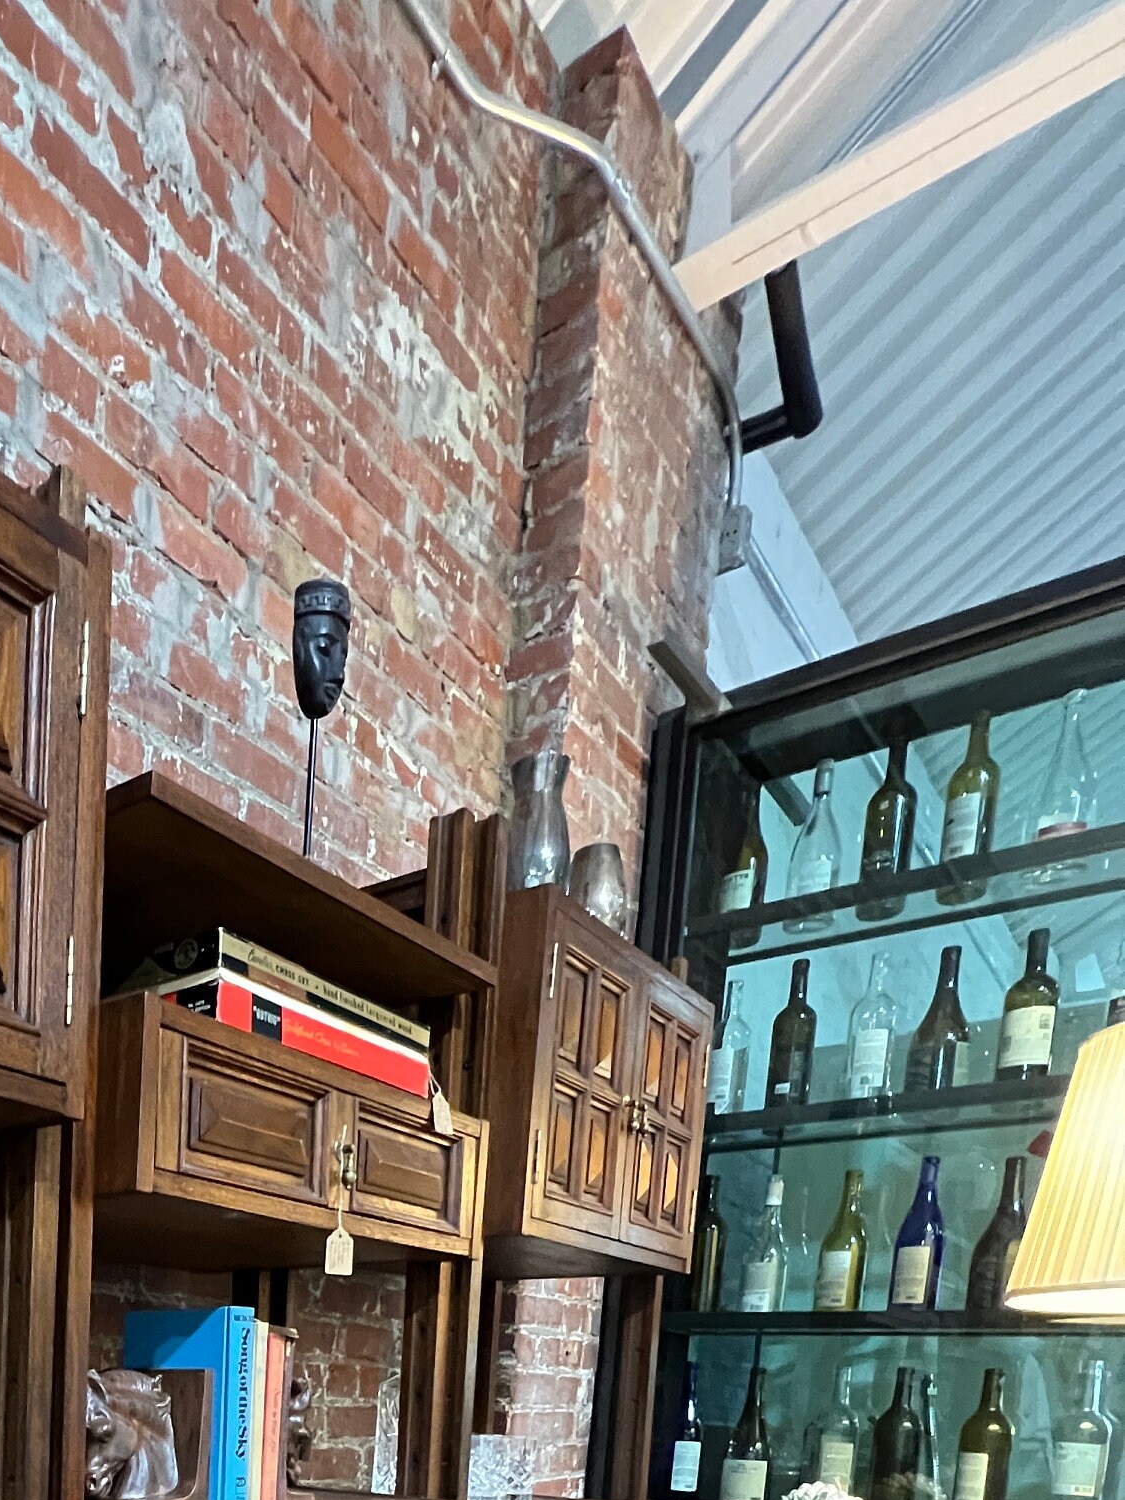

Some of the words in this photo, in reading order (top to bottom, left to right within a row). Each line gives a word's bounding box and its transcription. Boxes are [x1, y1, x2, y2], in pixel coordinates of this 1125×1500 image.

[238, 1327, 251, 1374] Song
[239, 1375, 249, 1395] of
[238, 1396, 248, 1423] the
[235, 1426, 249, 1458] Sky
